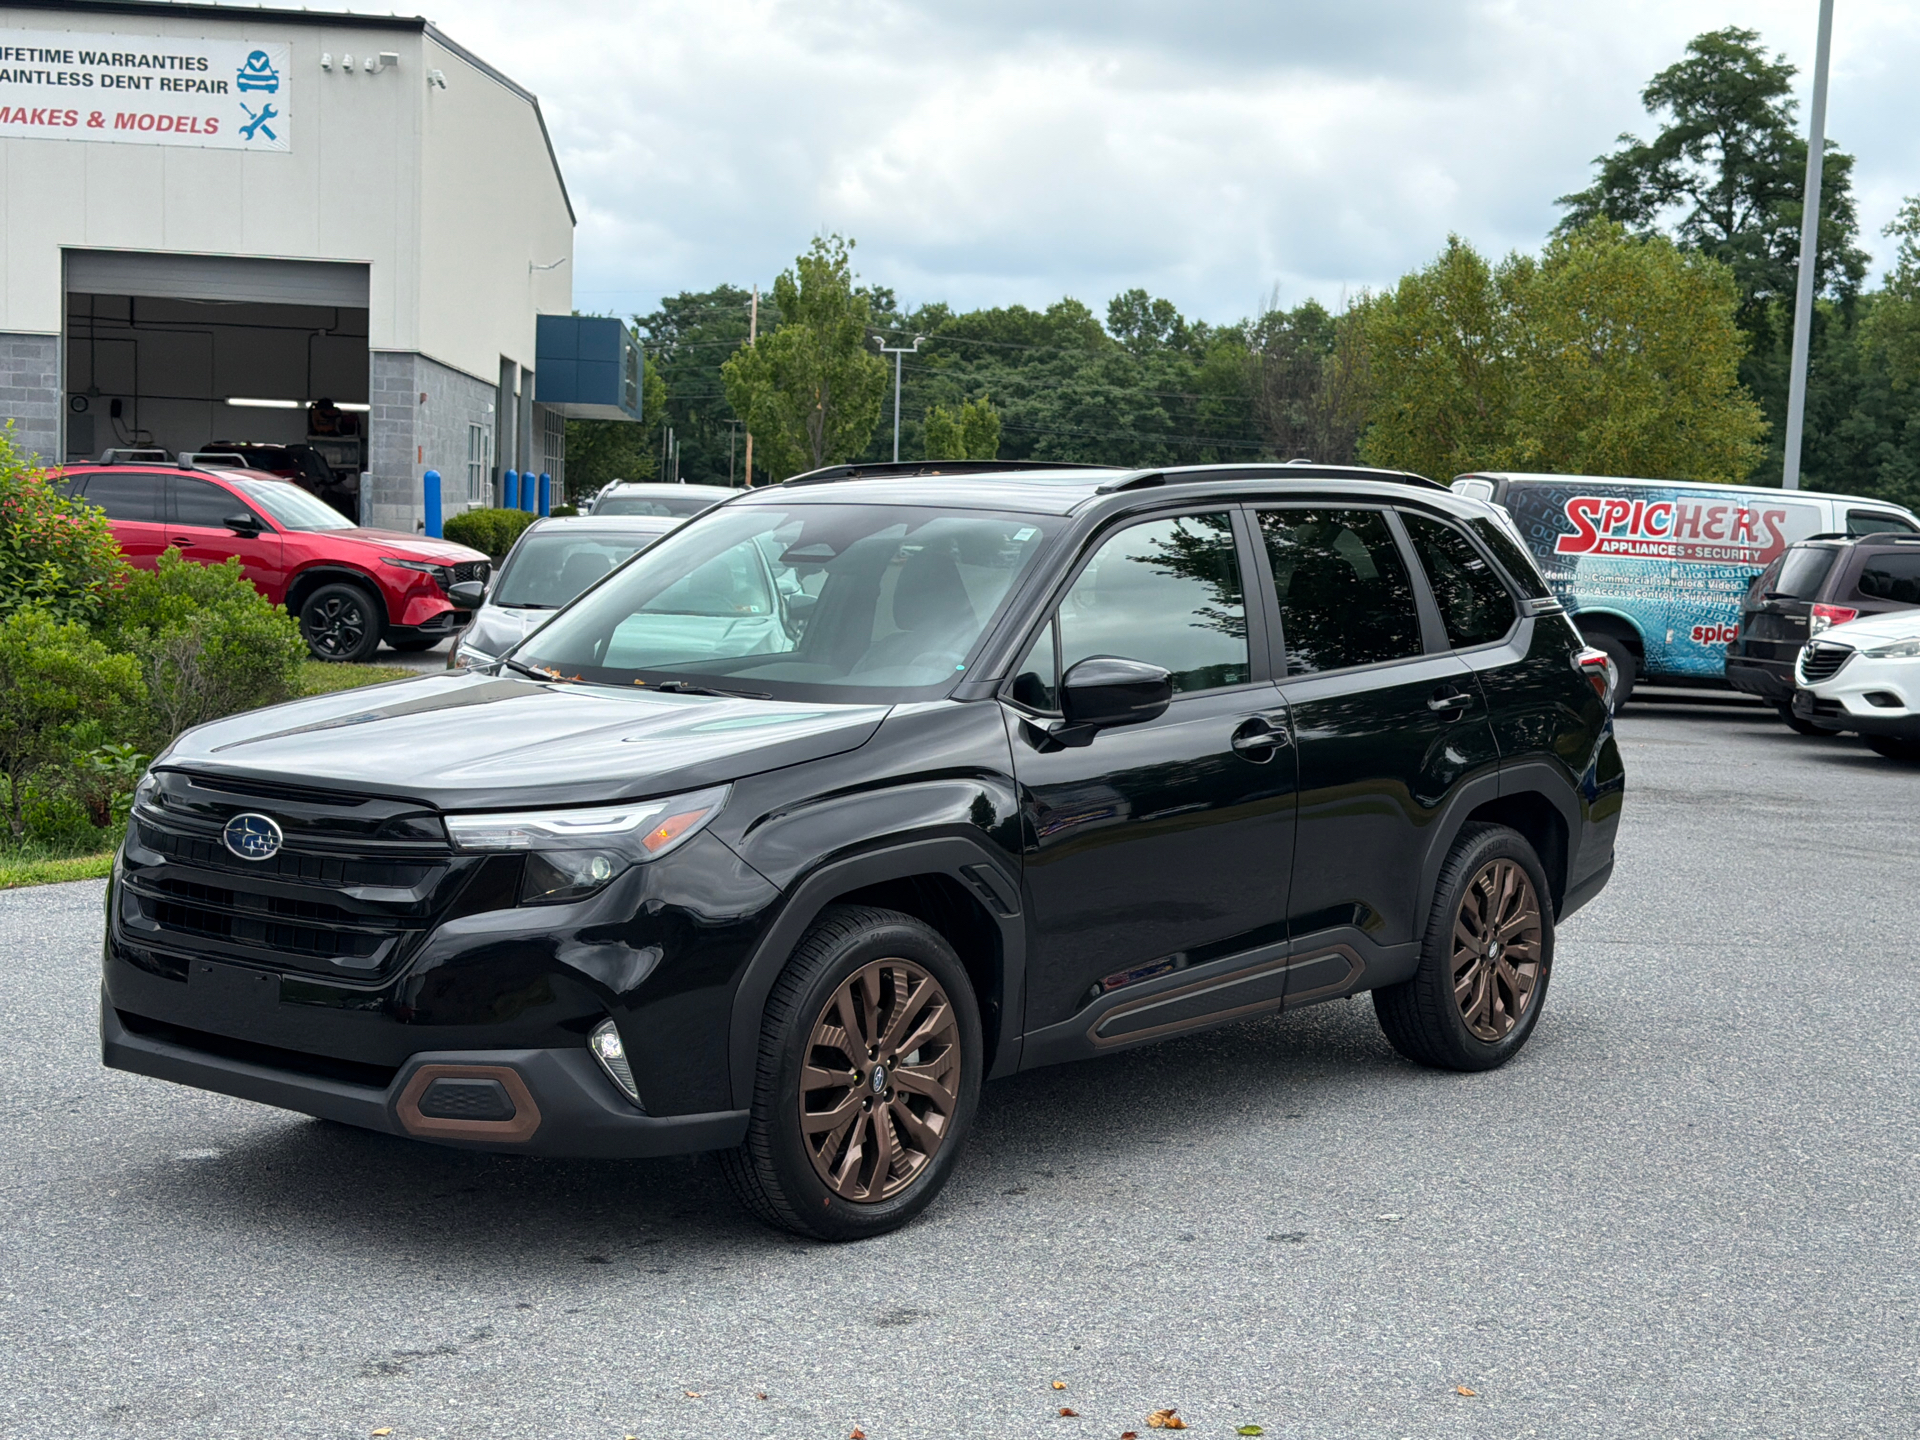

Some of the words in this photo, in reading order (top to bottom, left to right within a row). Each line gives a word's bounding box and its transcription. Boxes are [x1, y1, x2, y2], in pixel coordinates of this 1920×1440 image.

[79, 51, 209, 71] WARRANTIES
[101, 73, 153, 90] DENT
[160, 77, 228, 94] REPAIR
[86, 111, 105, 129] &
[114, 113, 220, 135] MODELS
[1555, 496, 1787, 556] SPICHERS
[1601, 541, 1685, 557] APPLIANCES
[1695, 547, 1761, 561] SECURITY
[1541, 570, 1580, 581] dential
[1592, 573, 1653, 585] Commercial
[1664, 578, 1693, 588] Audio
[1708, 580, 1737, 590] Video
[1566, 585, 1586, 594] Fire
[1594, 587, 1632, 597] Access
[1634, 589, 1672, 600] Control
[1684, 592, 1742, 604] Surveillanc
